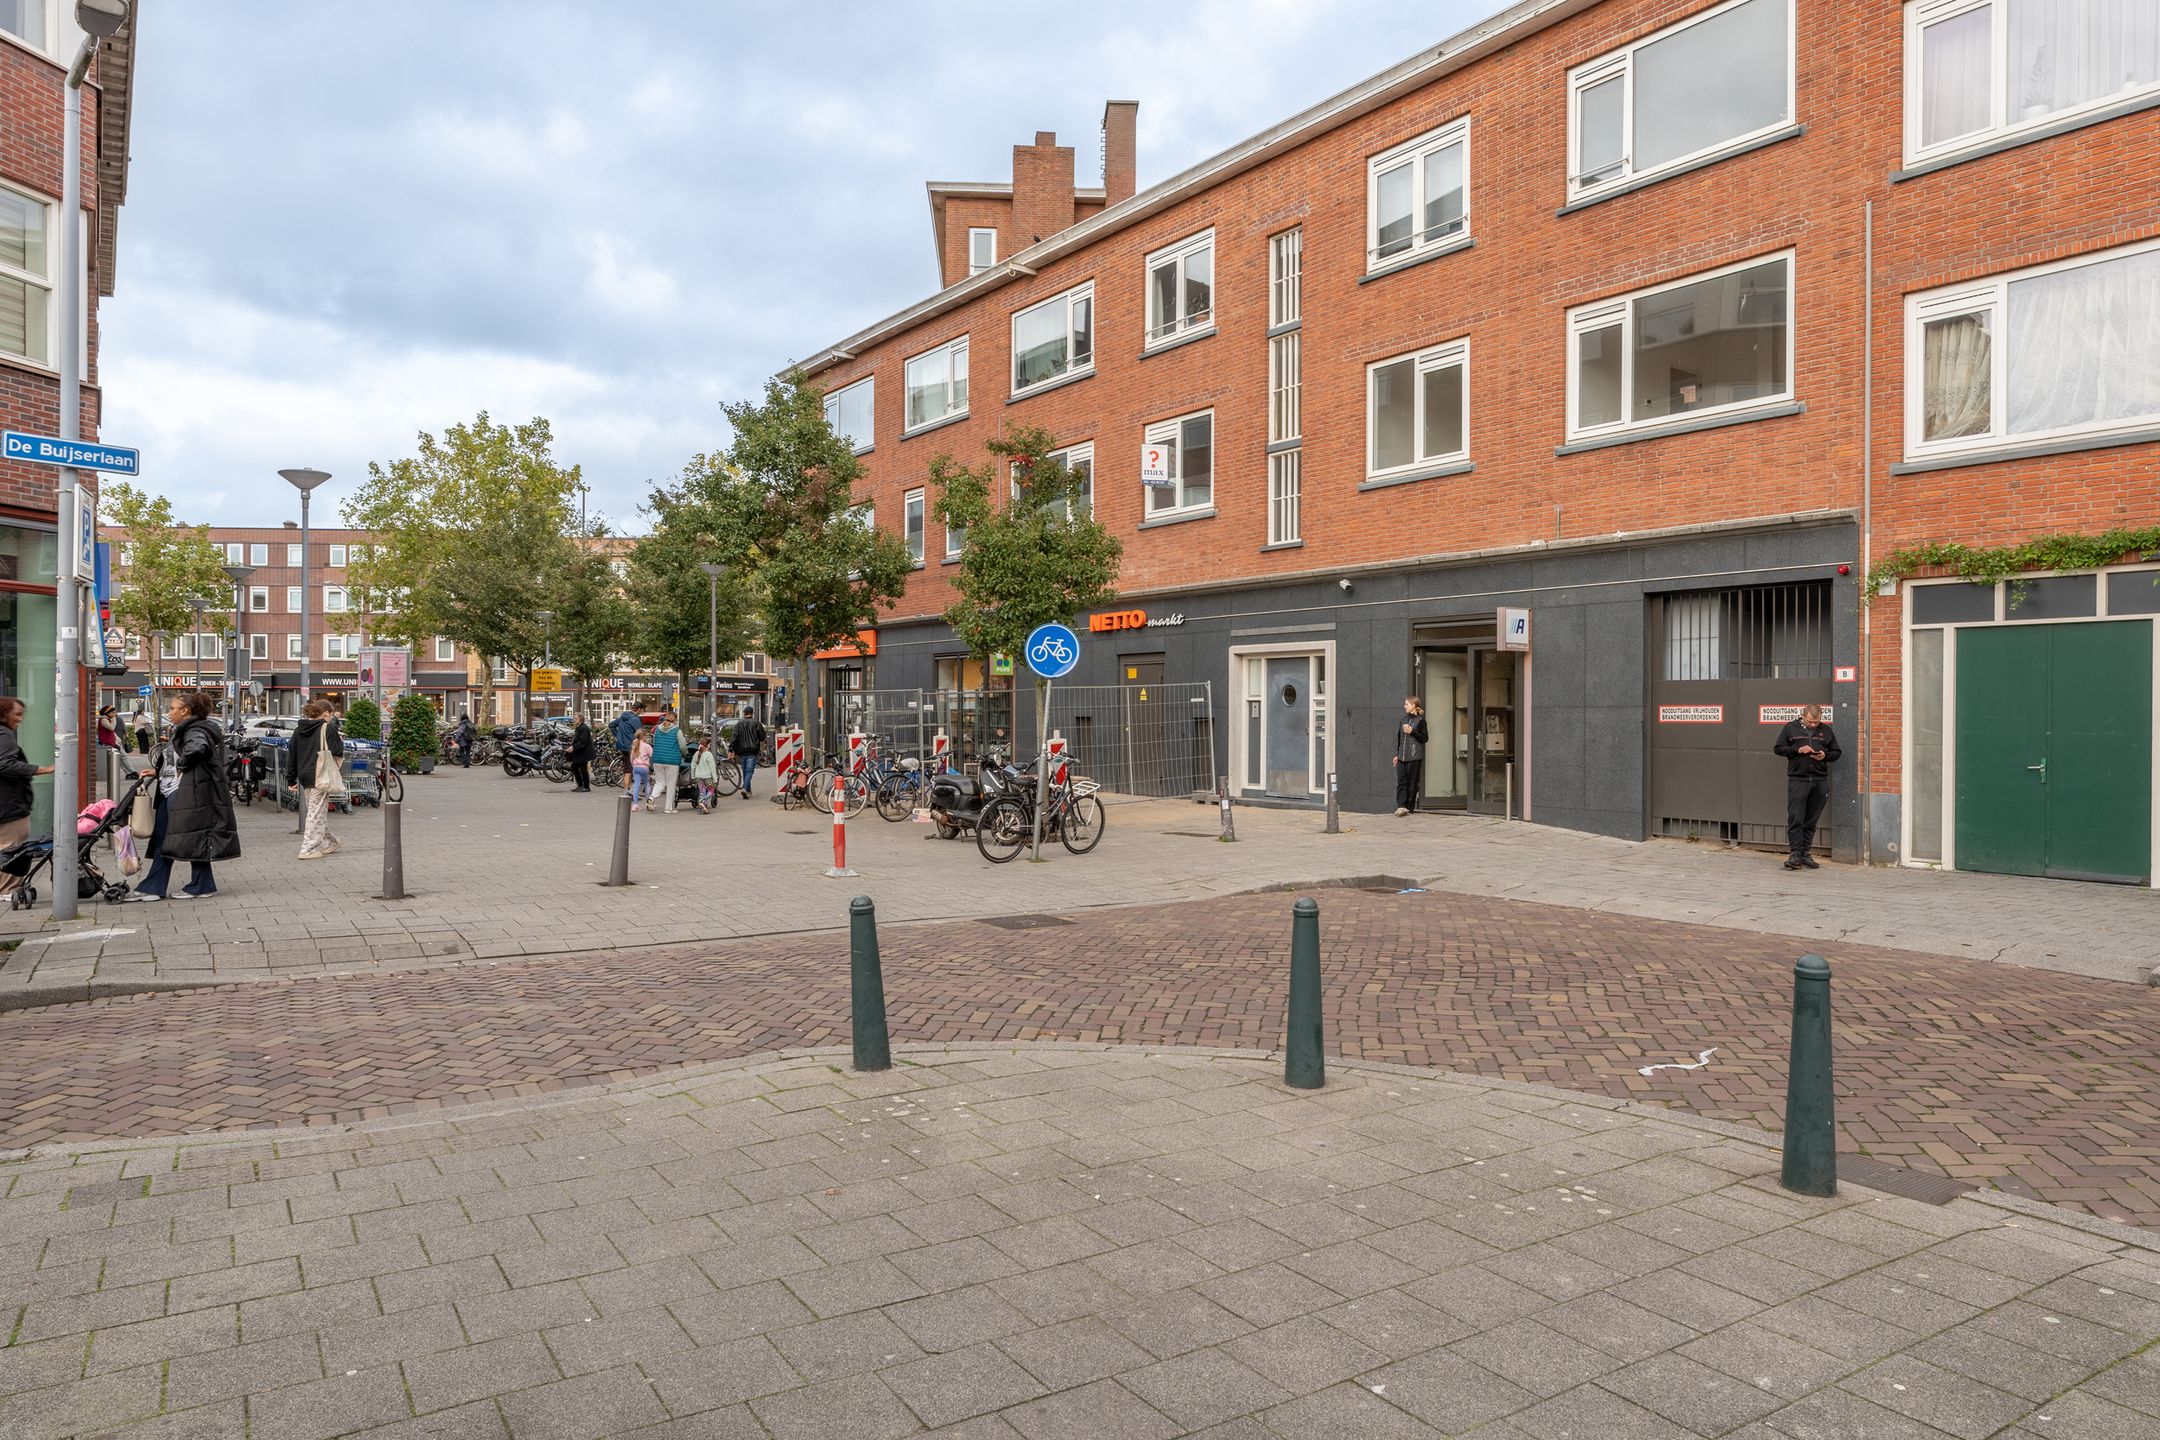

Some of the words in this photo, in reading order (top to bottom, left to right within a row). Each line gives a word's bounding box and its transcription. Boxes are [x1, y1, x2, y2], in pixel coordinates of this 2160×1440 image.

[8, 438, 32, 453] De
[40, 442, 133, 467] Buijserlaan
[1089, 609, 1146, 632] NETTO
[1147, 613, 1185, 627] markt
[1515, 618, 1525, 634] A
[155, 676, 197, 687] UNIQUE
